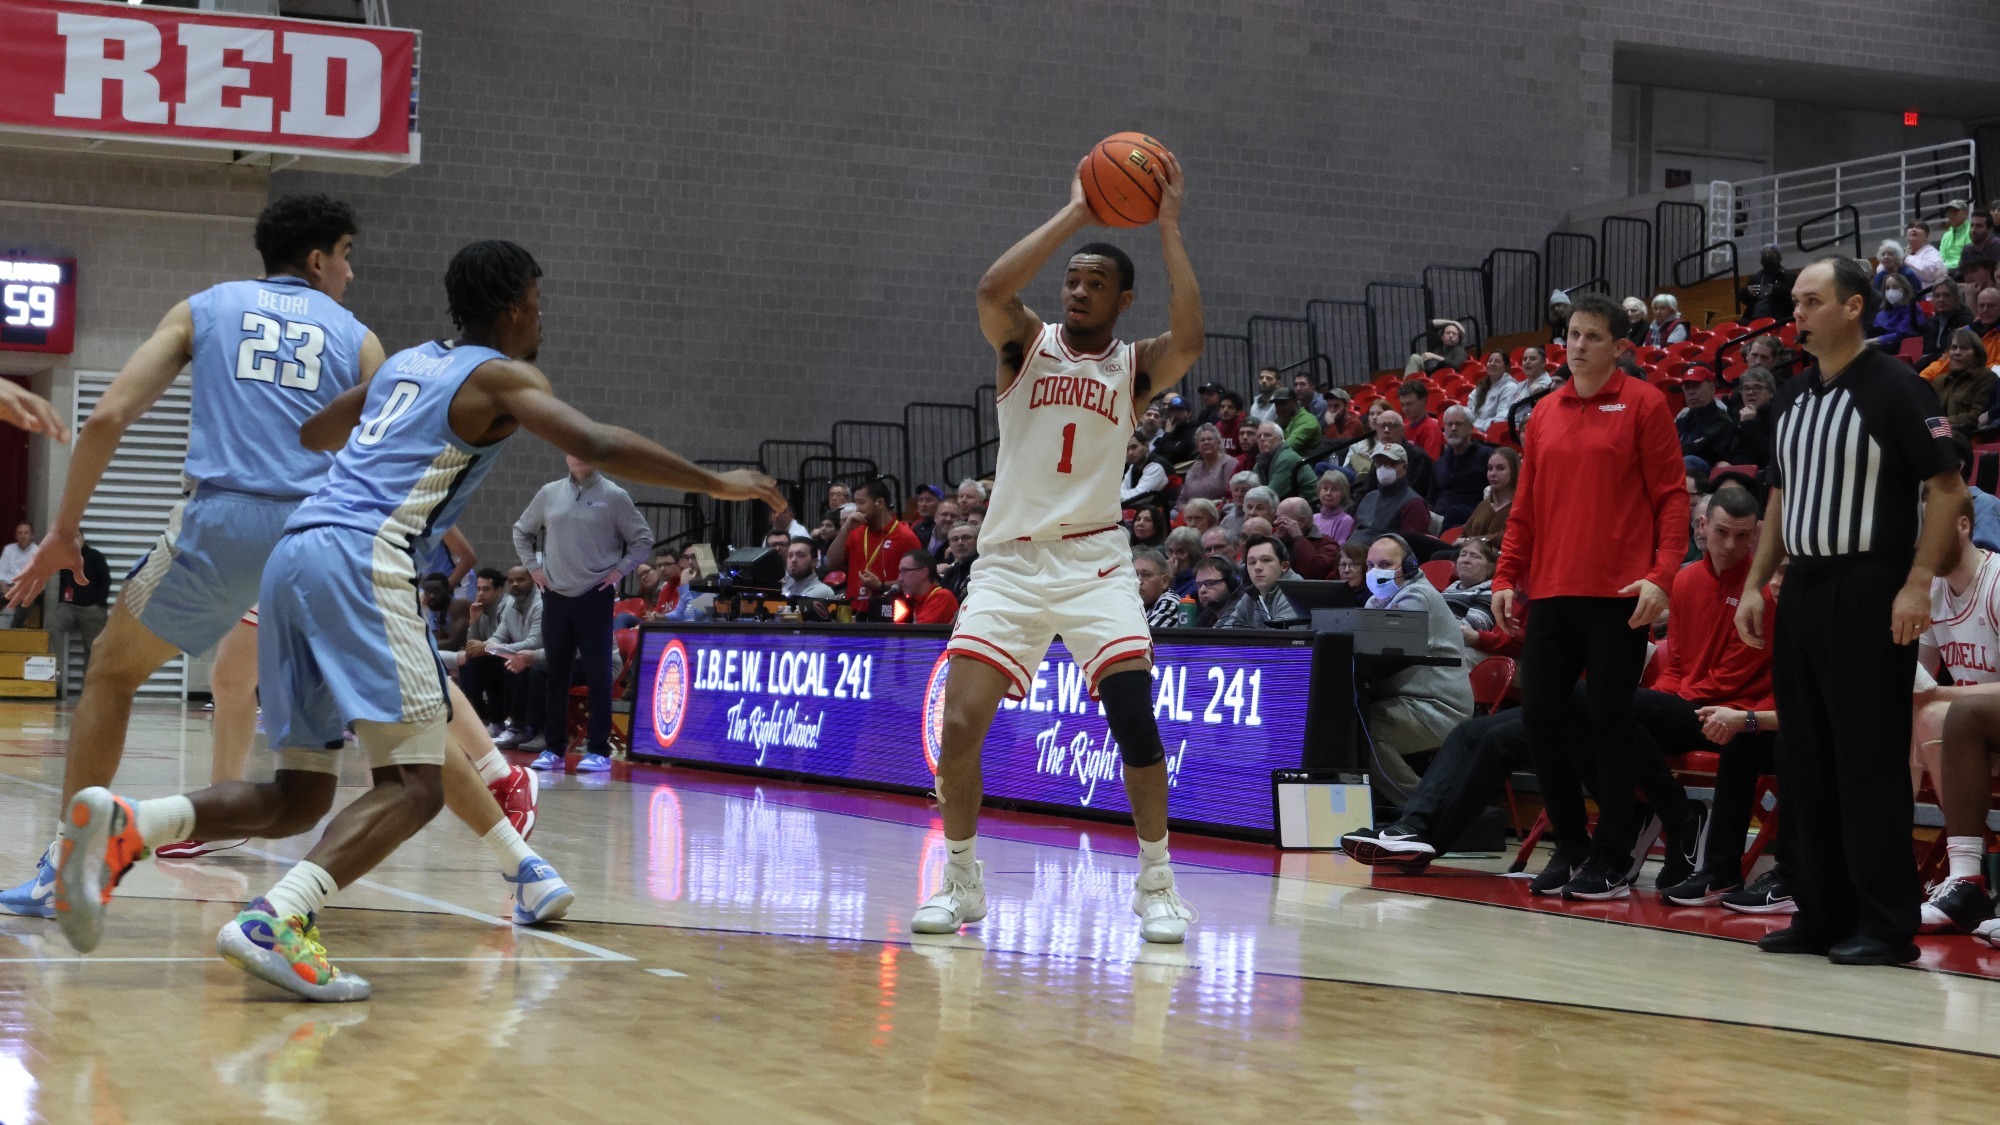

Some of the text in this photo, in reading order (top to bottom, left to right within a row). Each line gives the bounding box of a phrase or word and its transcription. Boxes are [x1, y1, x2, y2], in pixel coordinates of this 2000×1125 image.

[54, 12, 383, 139] RED
[4, 284, 55, 328] 59
[257, 288, 309, 315] BEDRI
[235, 311, 326, 393] 23
[396, 351, 455, 378] COOPER
[356, 379, 422, 447] 0
[1029, 375, 1118, 425] CORNELL
[1057, 422, 1077, 474] 1
[694, 649, 761, 693] I.B.E.W.
[767, 651, 829, 697] LOCAL
[834, 652, 872, 700] 241
[1204, 665, 1262, 726] 241
[727, 697, 824, 767] The Right Choice!
[1036, 719, 1066, 775] The
[1069, 726, 1119, 807] Right
